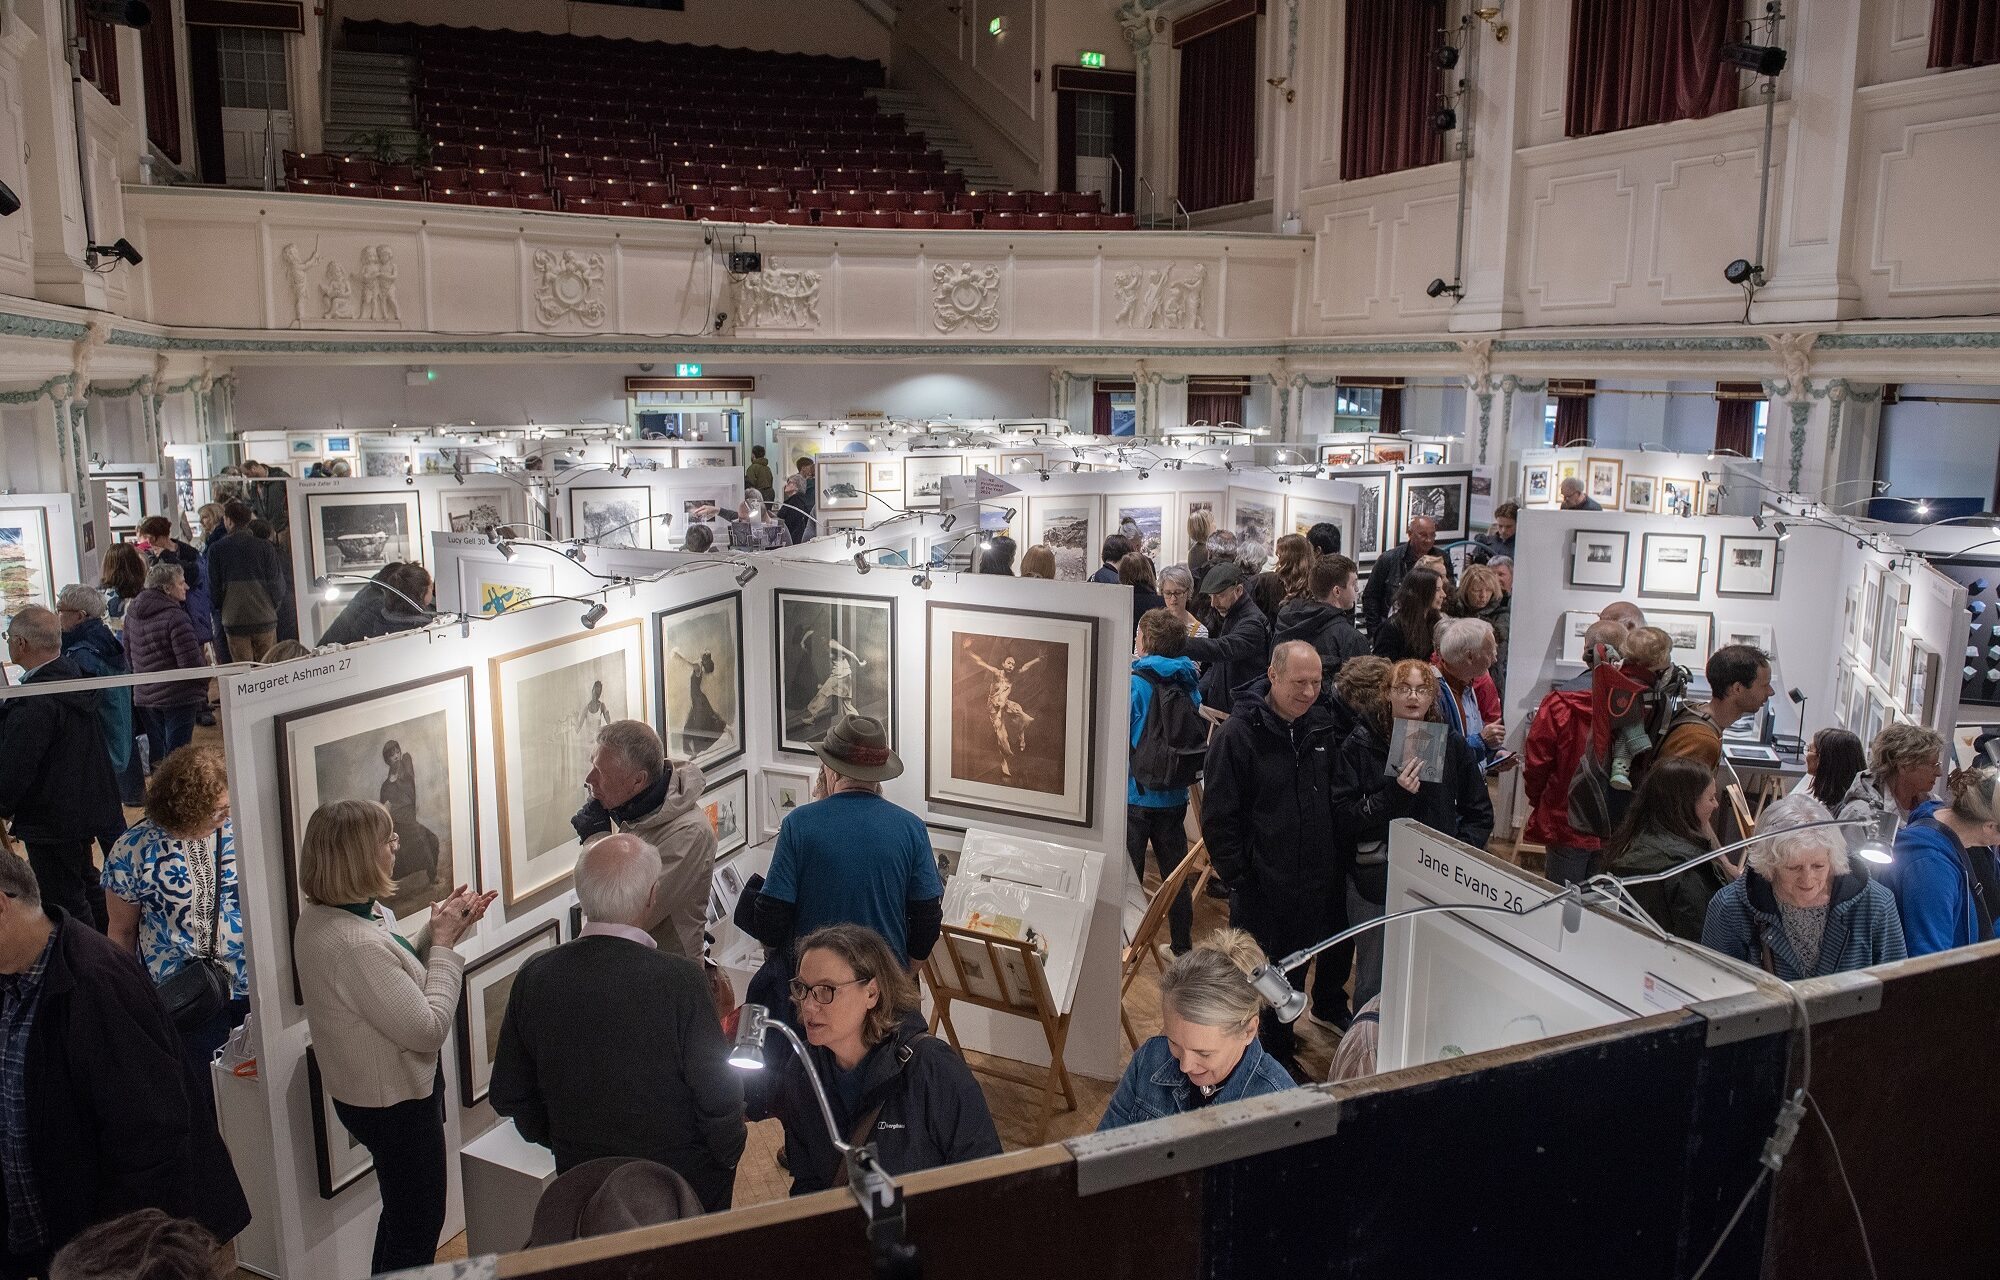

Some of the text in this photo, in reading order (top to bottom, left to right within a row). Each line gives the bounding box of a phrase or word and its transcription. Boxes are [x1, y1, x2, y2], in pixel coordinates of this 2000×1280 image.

[447, 535, 486, 546] Lucy Gell 30
[237, 658, 352, 696] Margaret Ashman 27
[1417, 847, 1523, 913] Jane Evans 26
